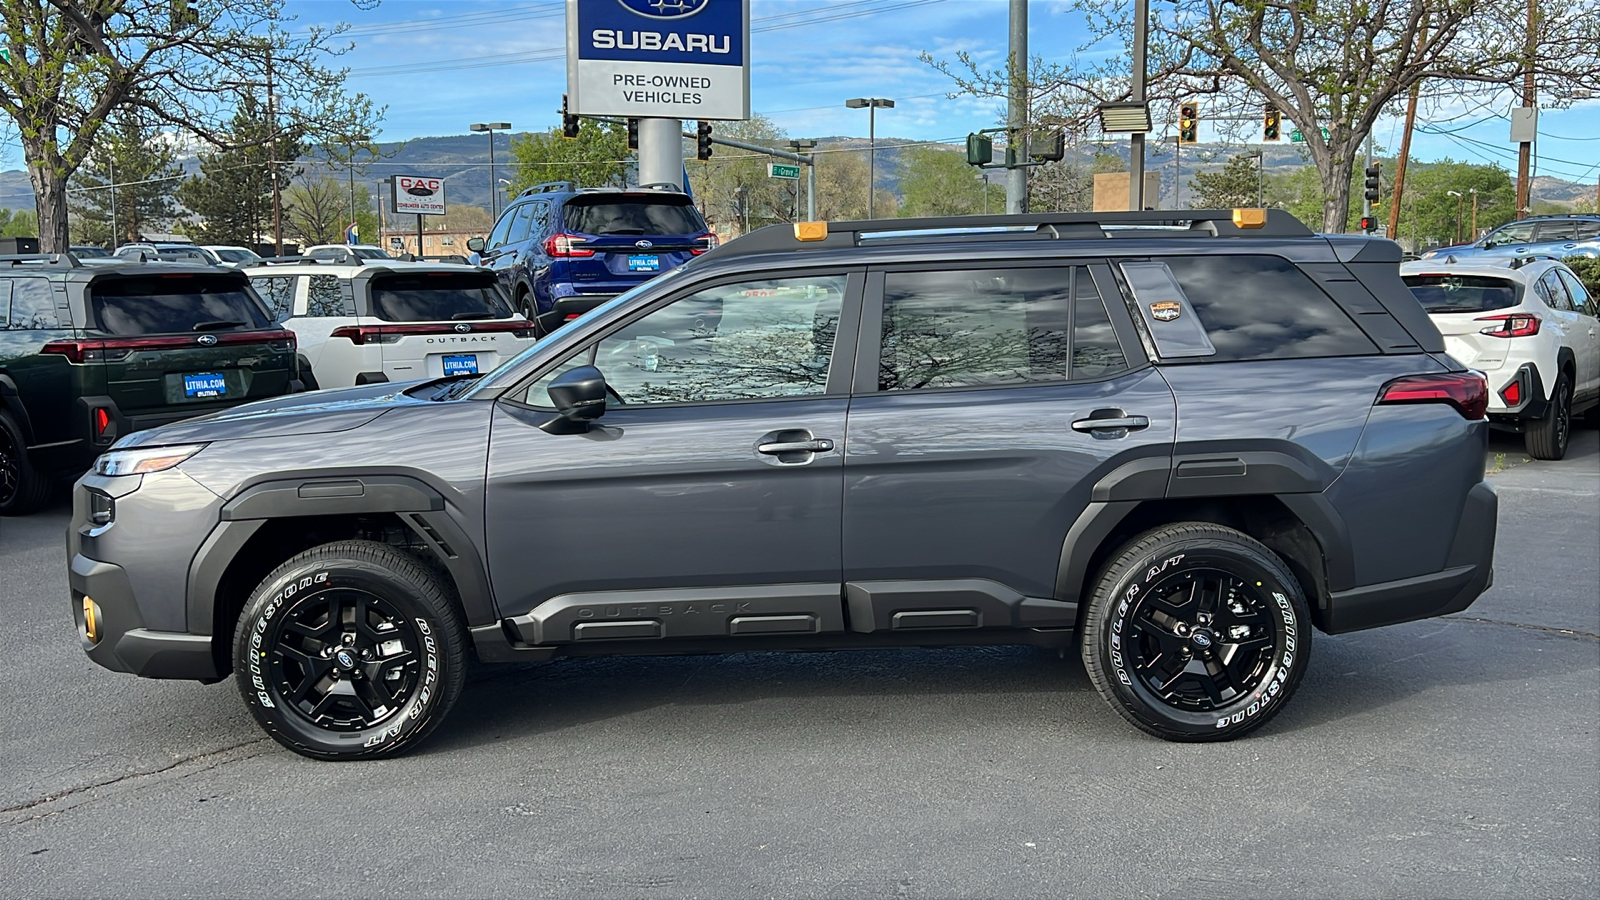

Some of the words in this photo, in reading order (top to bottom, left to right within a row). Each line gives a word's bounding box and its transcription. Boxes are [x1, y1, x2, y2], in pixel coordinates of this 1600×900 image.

[592, 29, 730, 54] SUBARU
[613, 74, 711, 89] PRE-OWNED
[623, 90, 702, 104] VEHICLES
[426, 336, 497, 344] OUTBACK
[444, 360, 477, 370] LITHIA.COM
[185, 379, 226, 390] LITHIA.COM
[577, 602, 751, 618] OUTBACK
[1110, 583, 1140, 686] DUELER
[1145, 554, 1186, 582] A/T
[249, 572, 329, 709] BRIDGESTONE
[409, 617, 437, 720] DUELER
[1216, 591, 1297, 728] BRIDGESTONE
[364, 721, 404, 748] A/T
